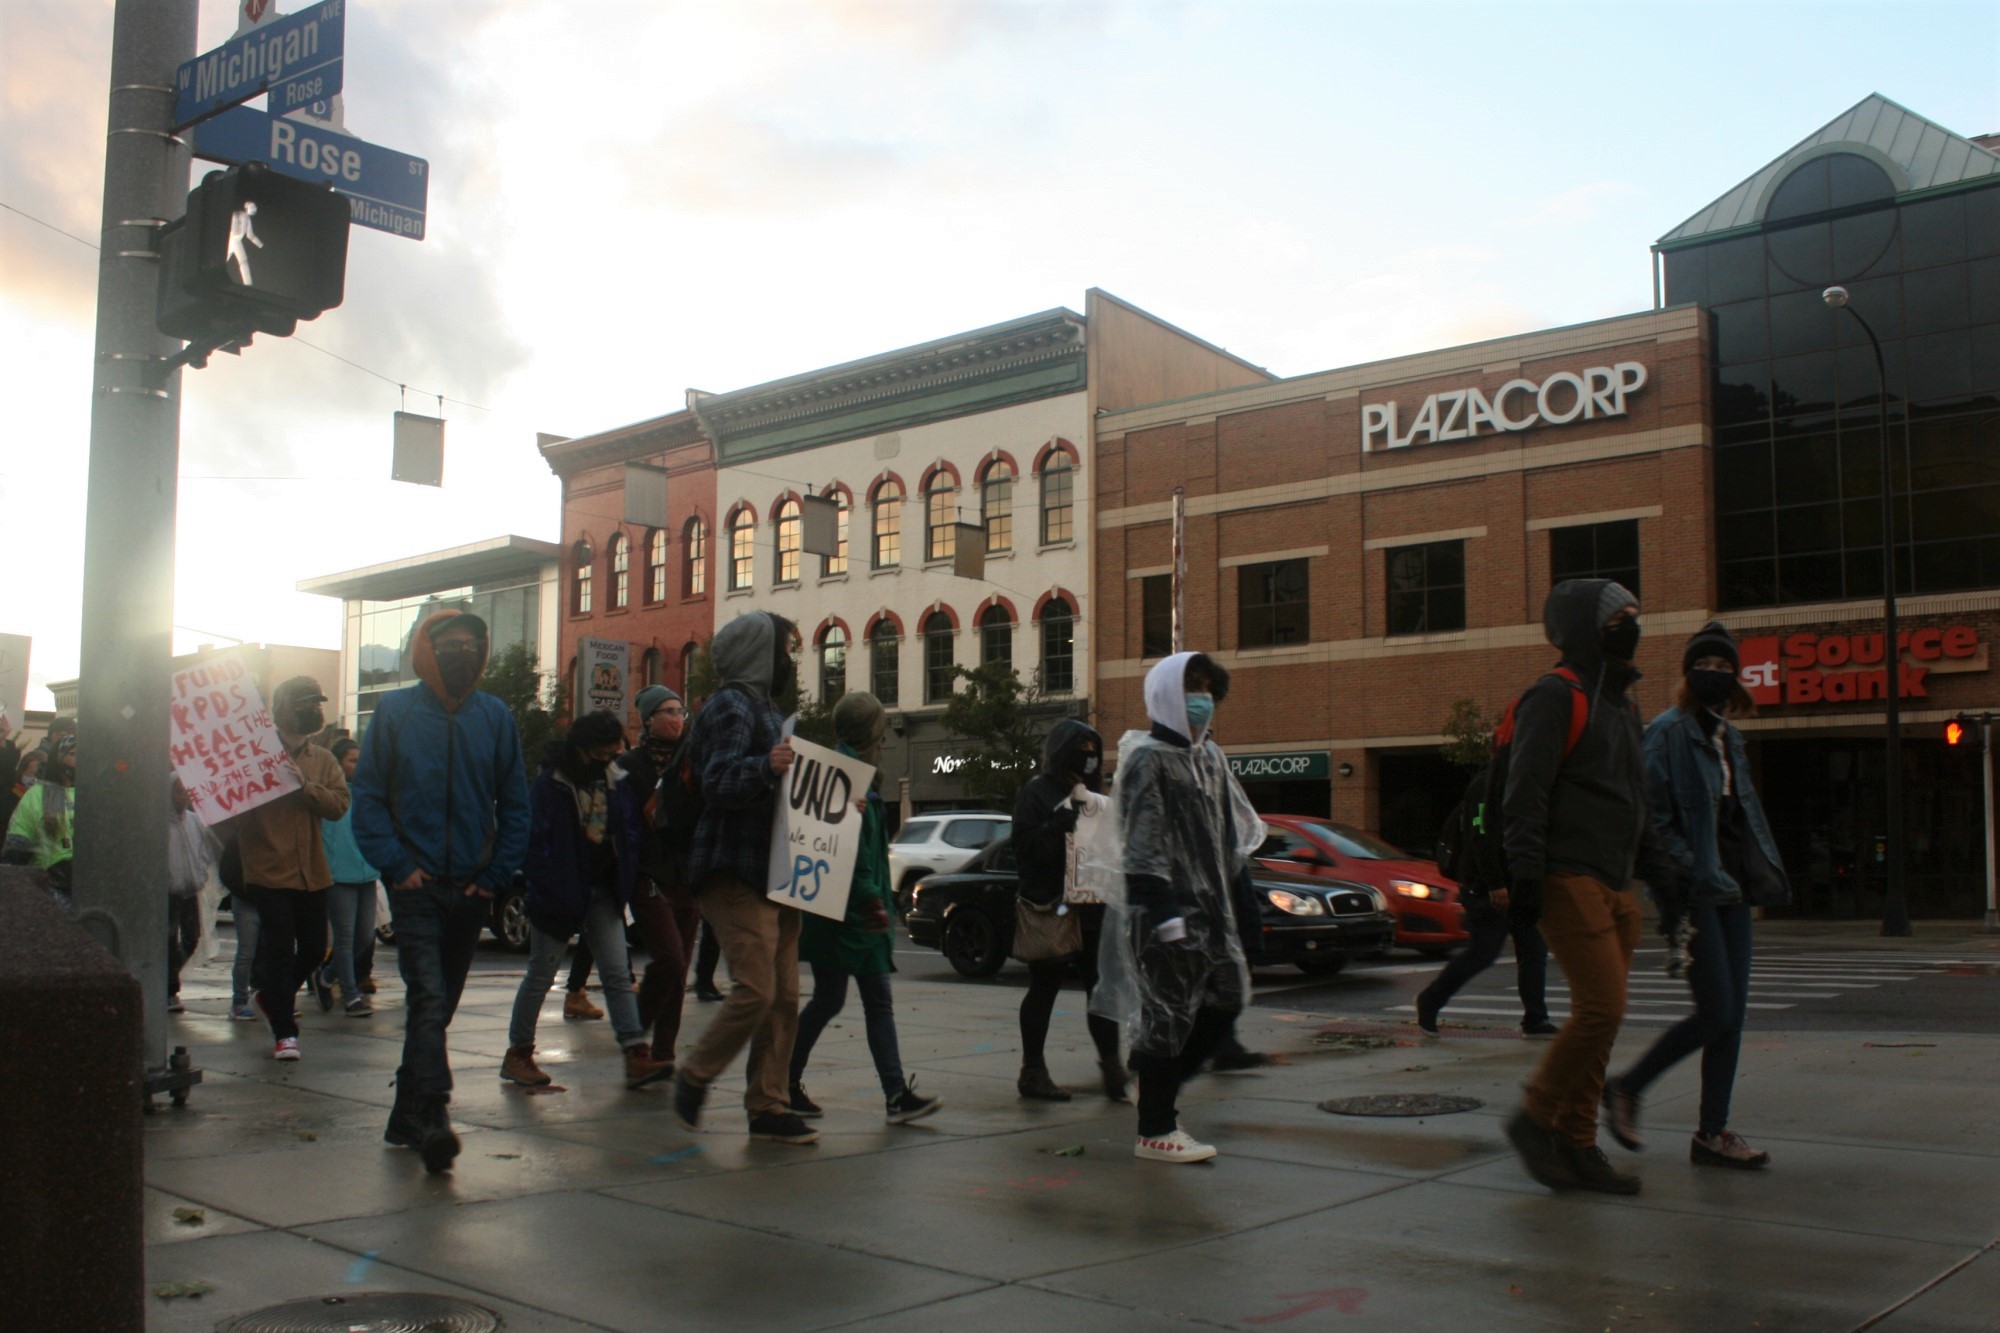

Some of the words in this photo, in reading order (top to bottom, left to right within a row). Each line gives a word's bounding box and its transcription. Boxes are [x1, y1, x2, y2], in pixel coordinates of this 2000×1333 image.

[179, 66, 191, 91] W
[195, 20, 319, 104] Michigan
[320, 3, 341, 22] AVE
[286, 77, 323, 107] Rose
[270, 119, 362, 182] Rose
[408, 161, 424, 176] ST
[350, 198, 423, 236] Michigan
[1361, 361, 1648, 452] PLAZACORP
[590, 641, 625, 652] MEXICAN
[596, 650, 618, 661] FOOD
[175, 659, 246, 699] FUND
[1786, 662, 1929, 705] Bank
[171, 684, 247, 735] KPDS
[170, 724, 242, 766] HEAL
[236, 710, 273, 732] THE
[202, 736, 268, 776] SICK
[220, 764, 253, 787] THE
[1231, 757, 1310, 775] PLAZACORP
[215, 772, 281, 812] WAR
[788, 752, 852, 825] UND
[813, 832, 840, 858] call
